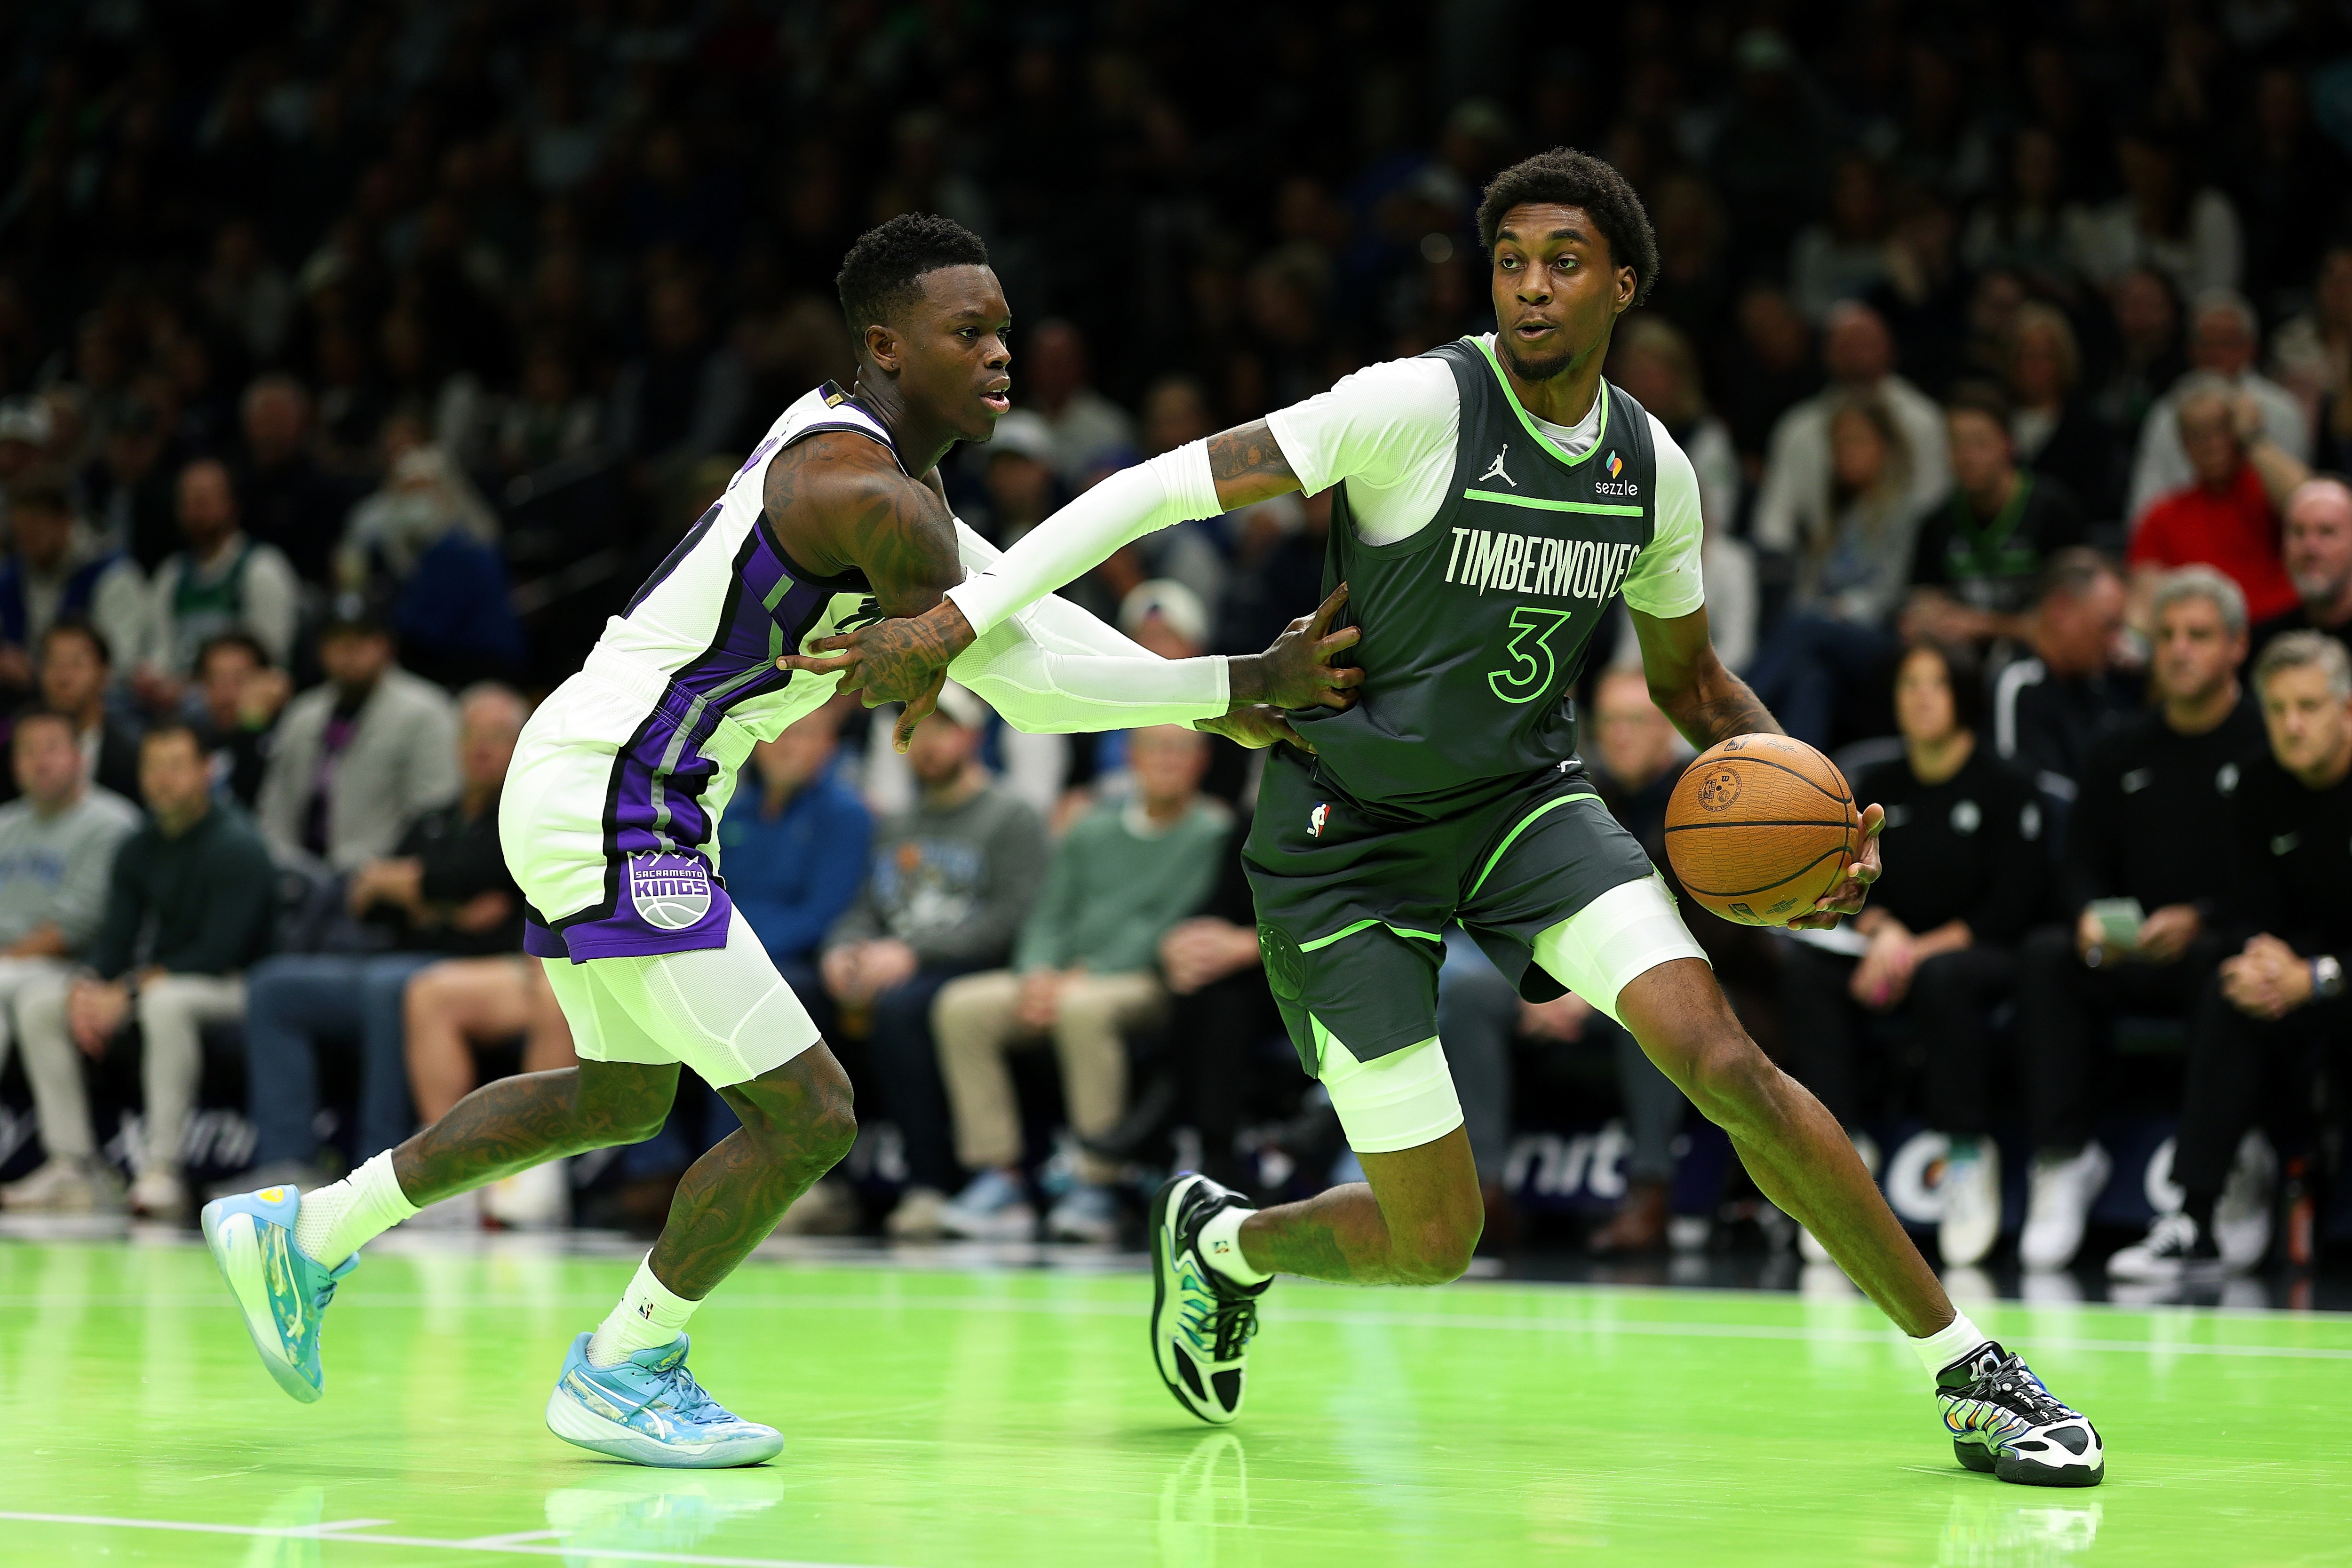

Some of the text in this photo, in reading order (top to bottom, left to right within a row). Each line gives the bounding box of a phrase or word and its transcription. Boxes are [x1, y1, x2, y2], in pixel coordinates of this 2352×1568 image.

[1595, 479, 1638, 496] sezzle
[1488, 606, 1572, 704] 3
[636, 870, 703, 878] SACRAMENTO
[635, 880, 708, 898] KINGS
[2014, 1391, 2034, 1409] EYBL
